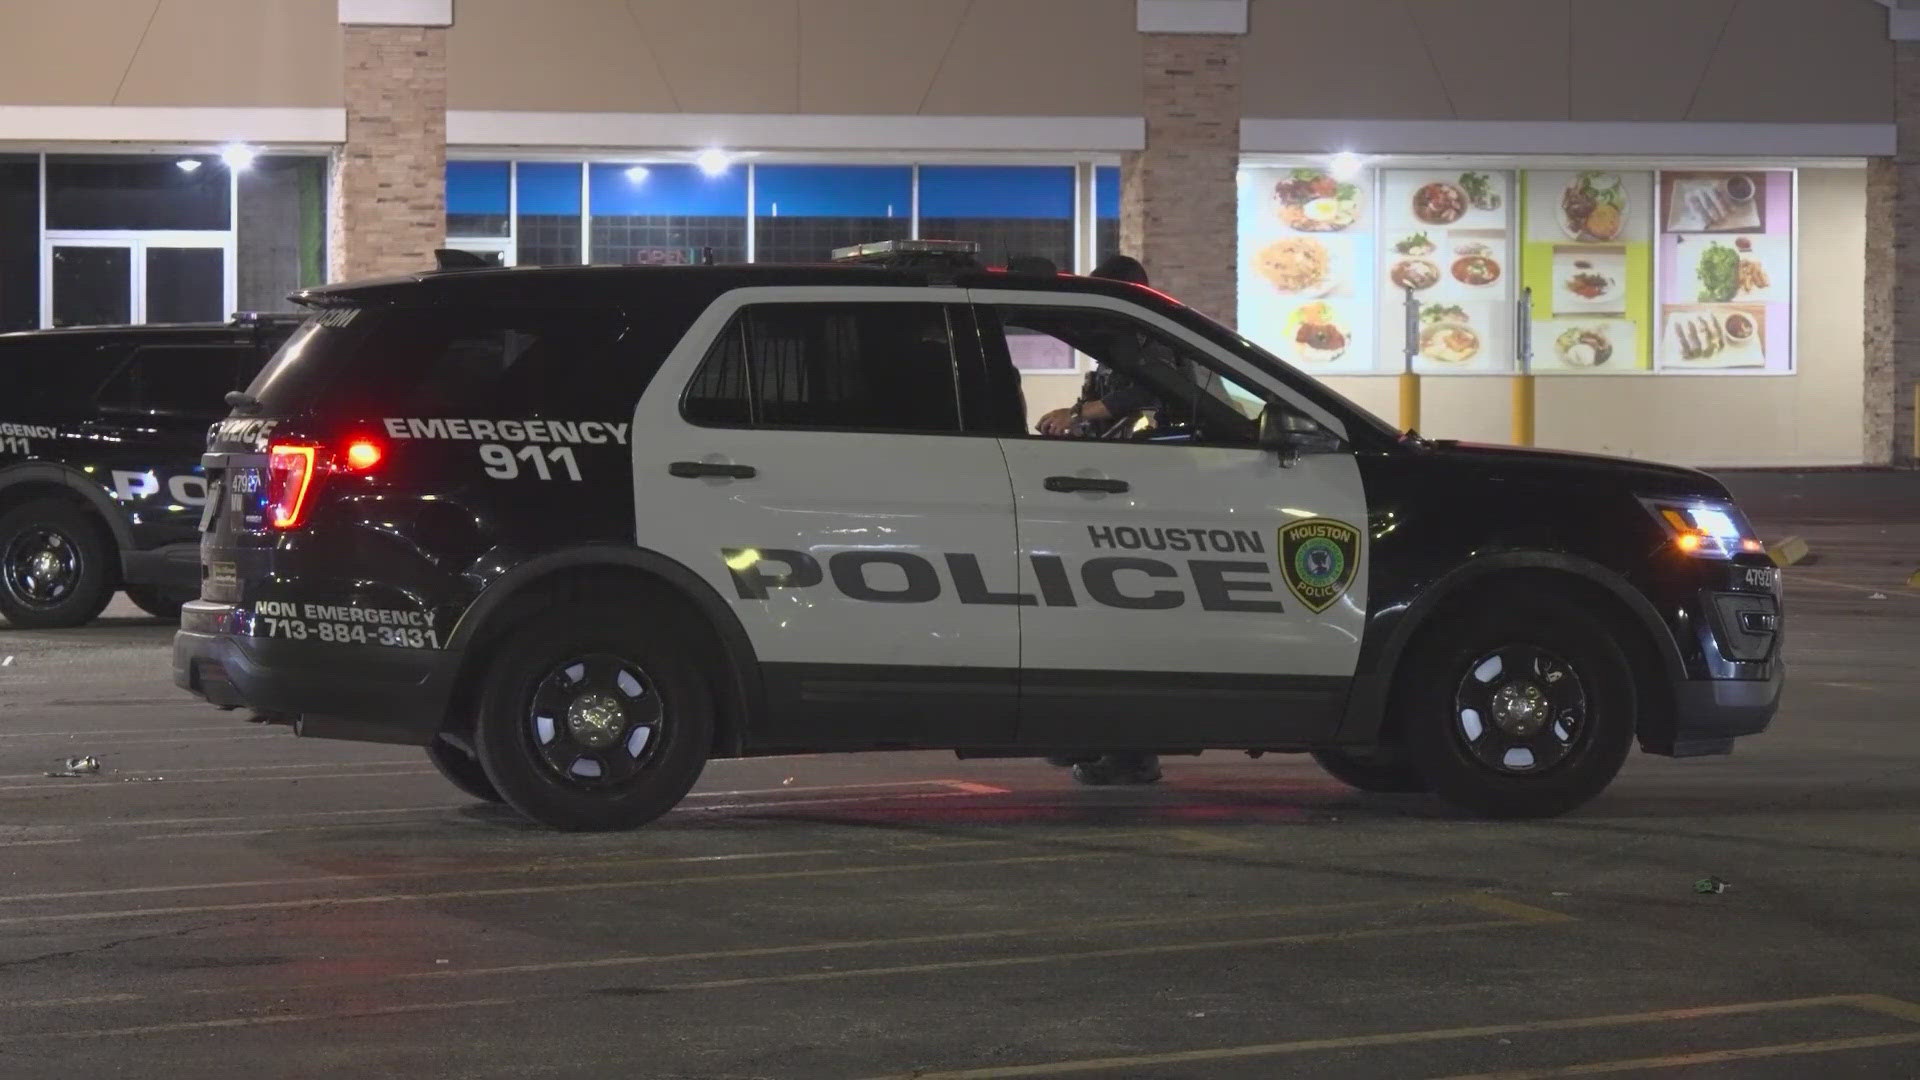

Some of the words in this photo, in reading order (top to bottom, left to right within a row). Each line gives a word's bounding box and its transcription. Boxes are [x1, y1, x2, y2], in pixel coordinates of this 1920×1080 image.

[0, 422, 57, 439] GENCY
[383, 418, 628, 444] EMERGENCY
[479, 443, 583, 481] 911
[1087, 525, 1265, 553] HOUSTON
[1290, 525, 1351, 543] HOUSTON
[720, 548, 1284, 613] POLICE
[1297, 581, 1342, 597] POLICE
[255, 601, 297, 617] NON
[304, 604, 435, 627] EMERGENCY
[264, 617, 440, 649] 713-884-3131
